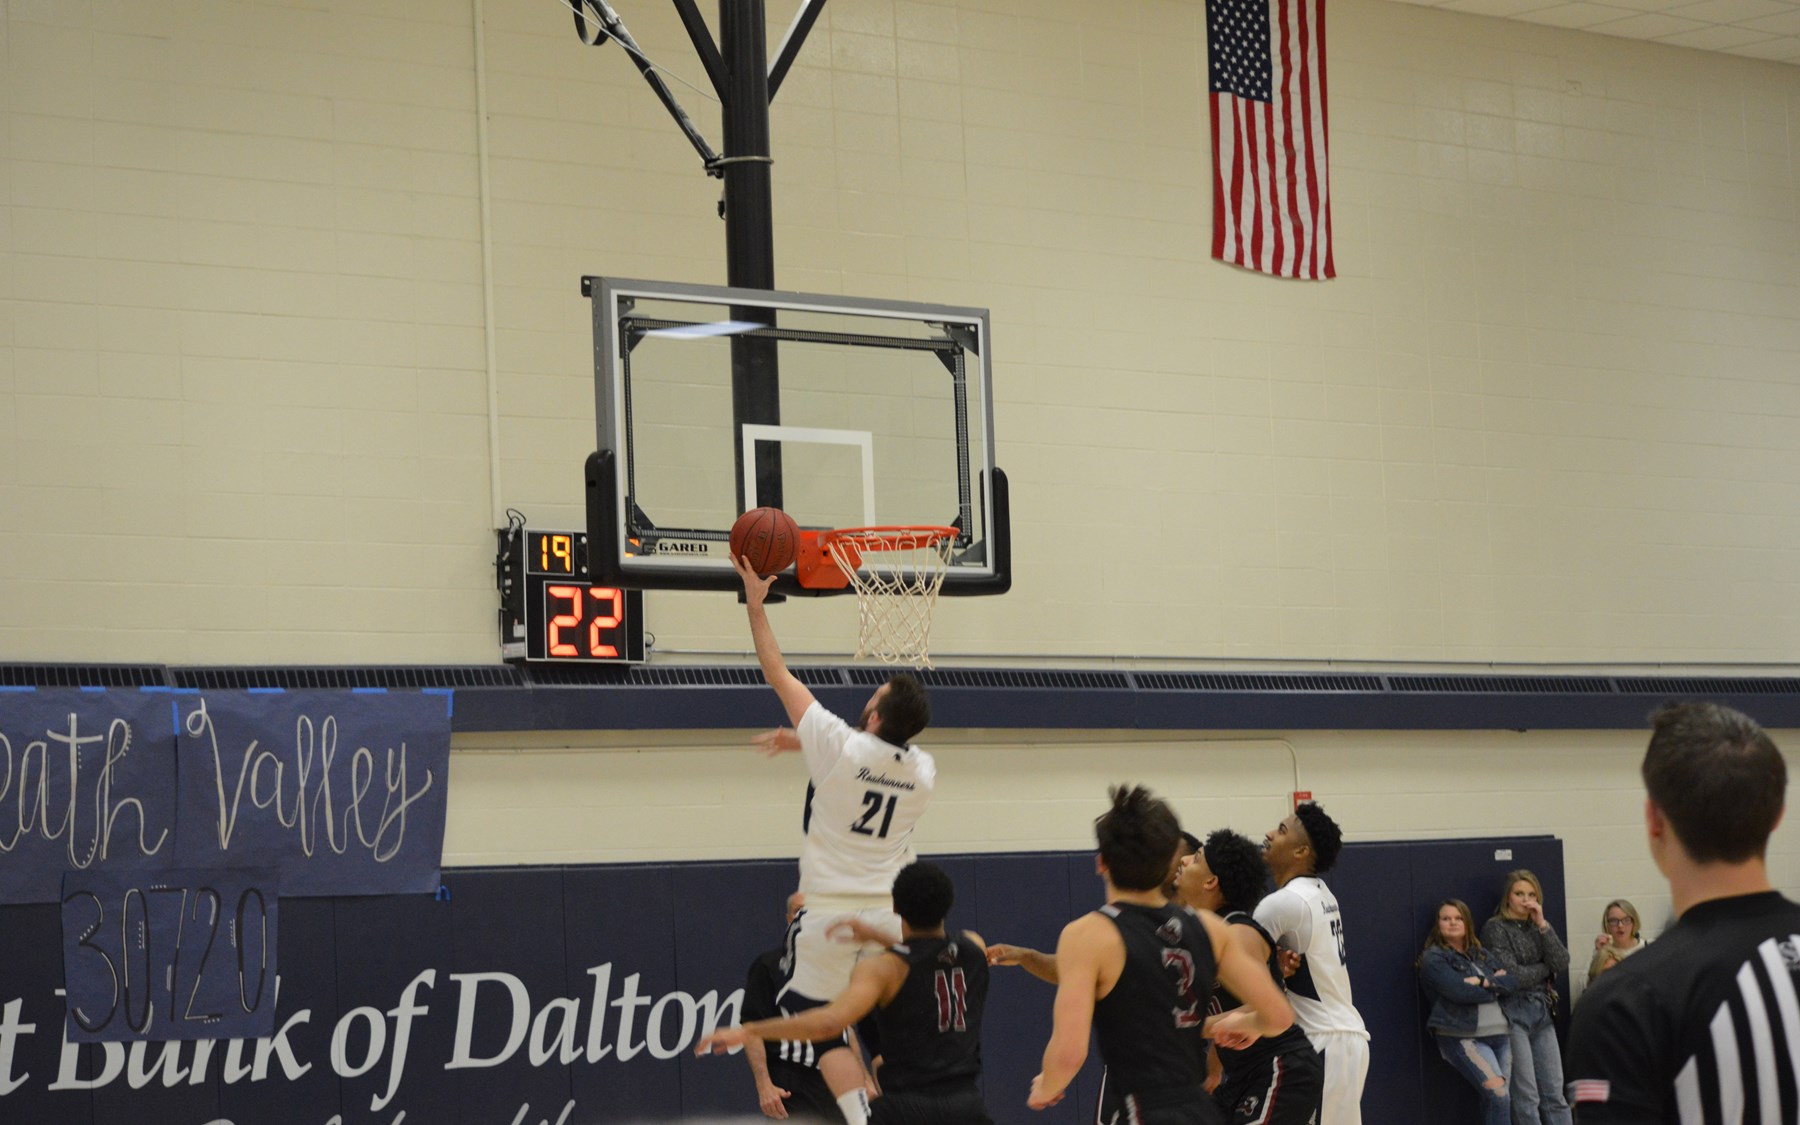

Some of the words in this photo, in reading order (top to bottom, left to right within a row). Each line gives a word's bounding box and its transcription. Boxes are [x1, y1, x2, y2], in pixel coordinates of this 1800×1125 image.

[541, 535, 571, 572] 19
[659, 542, 708, 553] GARED
[548, 586, 622, 657] 22
[186, 698, 433, 862] Valley
[855, 767, 916, 791] Roadrunners
[851, 790, 898, 838] 21
[62, 887, 267, 1033] 30720
[934, 967, 967, 1032] 11
[330, 968, 437, 1112] of
[444, 961, 746, 1070] Dalton
